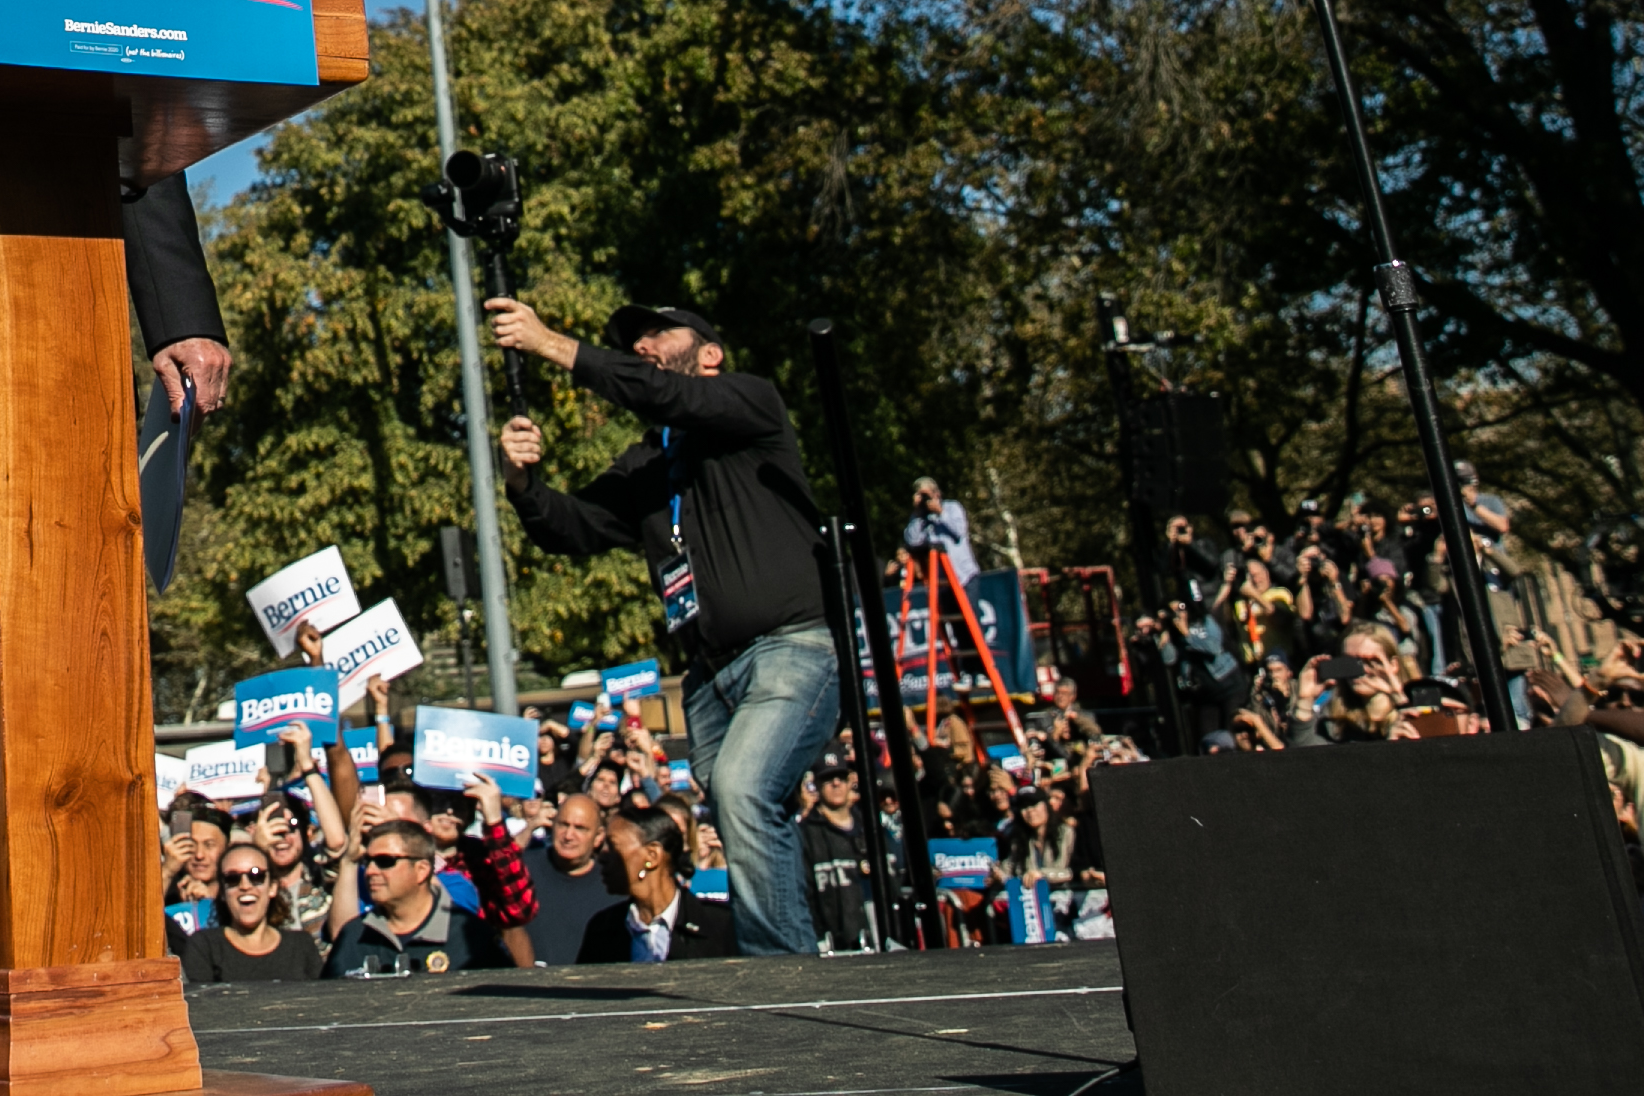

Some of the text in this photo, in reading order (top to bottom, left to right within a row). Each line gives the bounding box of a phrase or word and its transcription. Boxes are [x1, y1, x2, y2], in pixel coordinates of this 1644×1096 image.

[64, 19, 188, 41] BernieSanders.com
[95, 45, 108, 53] Bernie
[125, 45, 139, 56] (not
[139, 48, 150, 57] the
[263, 575, 341, 629] Bernie
[324, 626, 401, 675] ernie
[606, 670, 657, 694] Bernie
[241, 686, 334, 725] Bernie
[424, 729, 531, 769] Bernie
[189, 756, 256, 780] Bernie
[934, 852, 991, 872] Bernie
